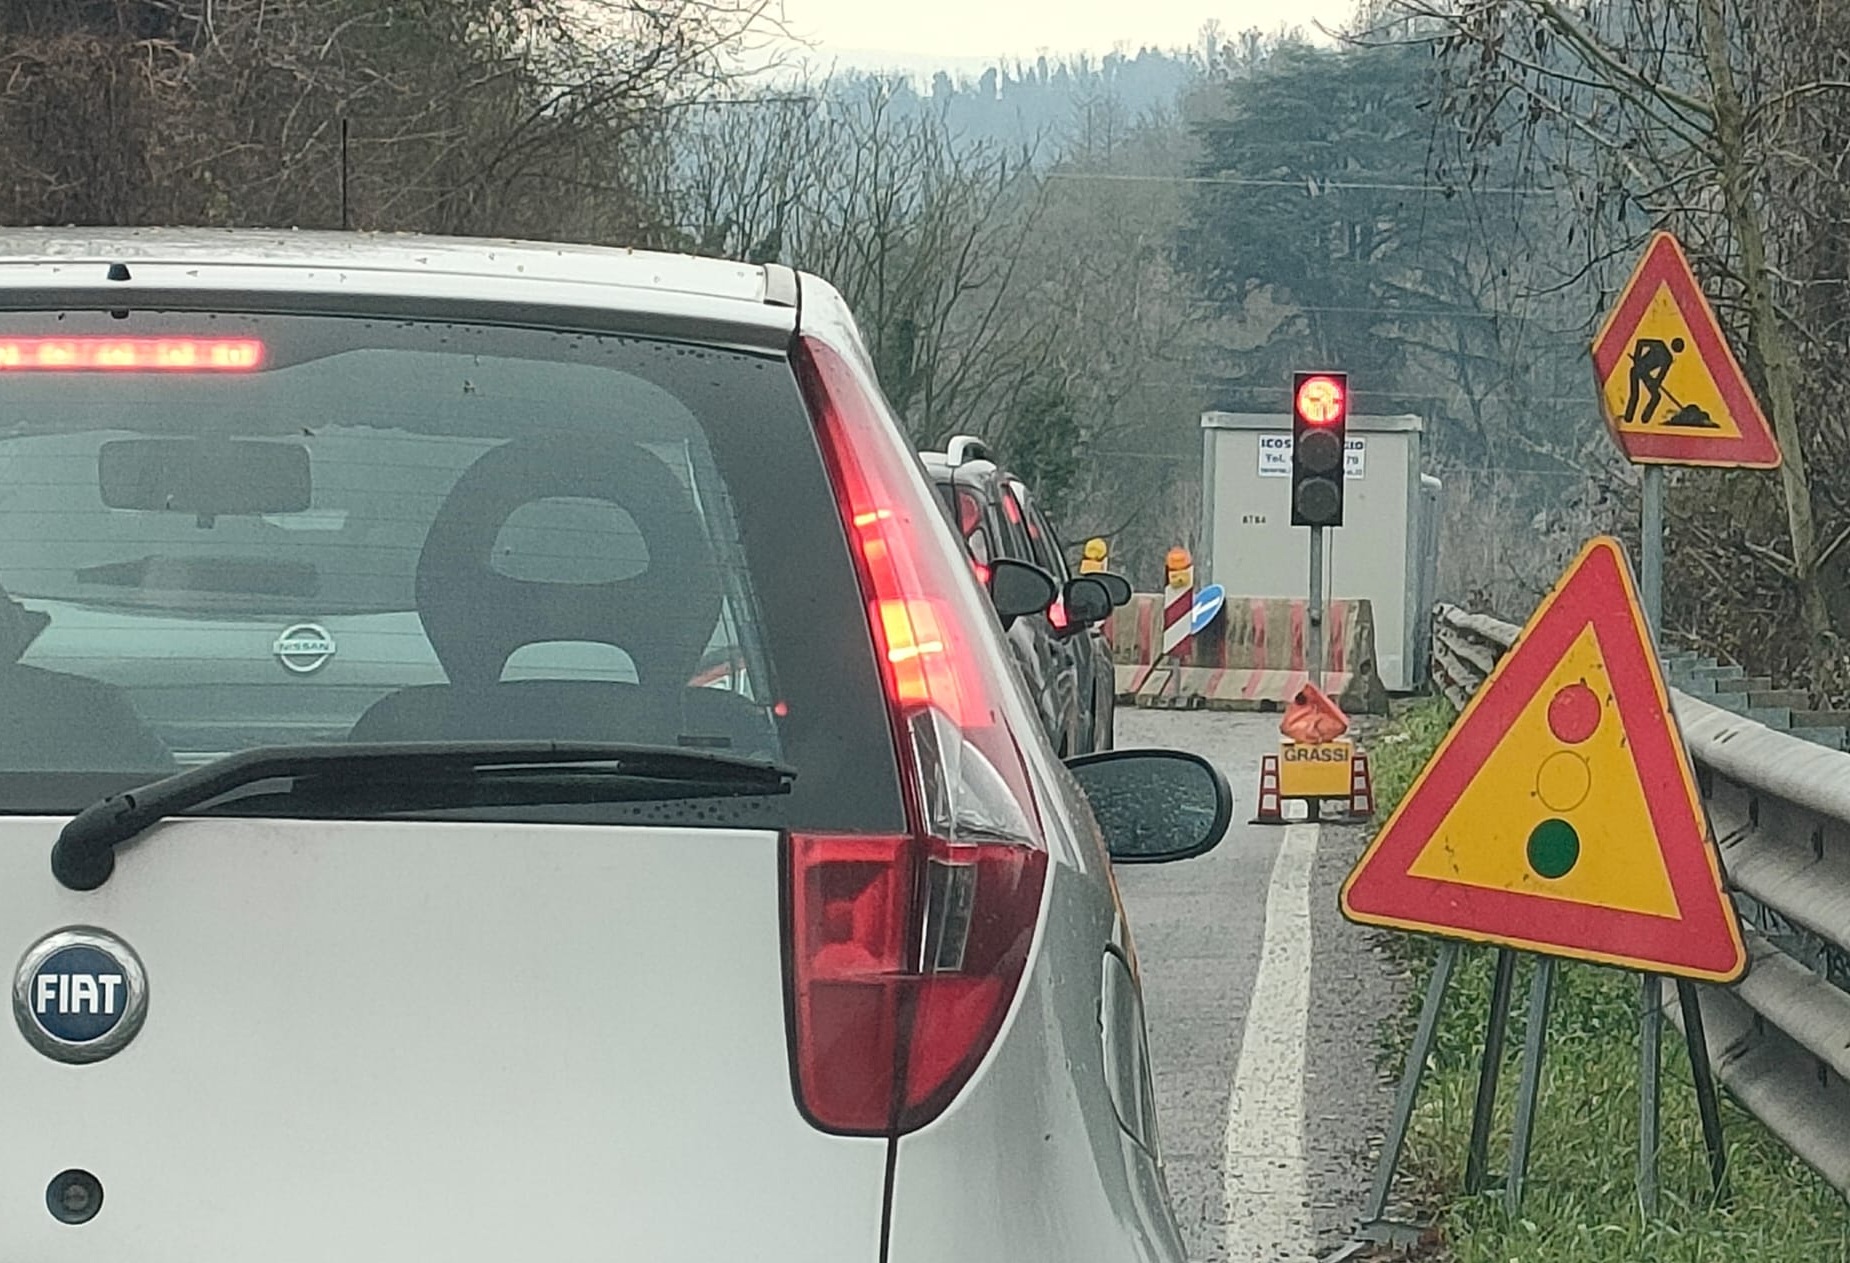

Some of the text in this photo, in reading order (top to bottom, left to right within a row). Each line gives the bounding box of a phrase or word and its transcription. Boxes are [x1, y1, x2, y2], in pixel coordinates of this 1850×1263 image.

[279, 642, 330, 652] NISSAN
[1284, 747, 1349, 762] GRASSI
[36, 973, 123, 1014] FIAT
